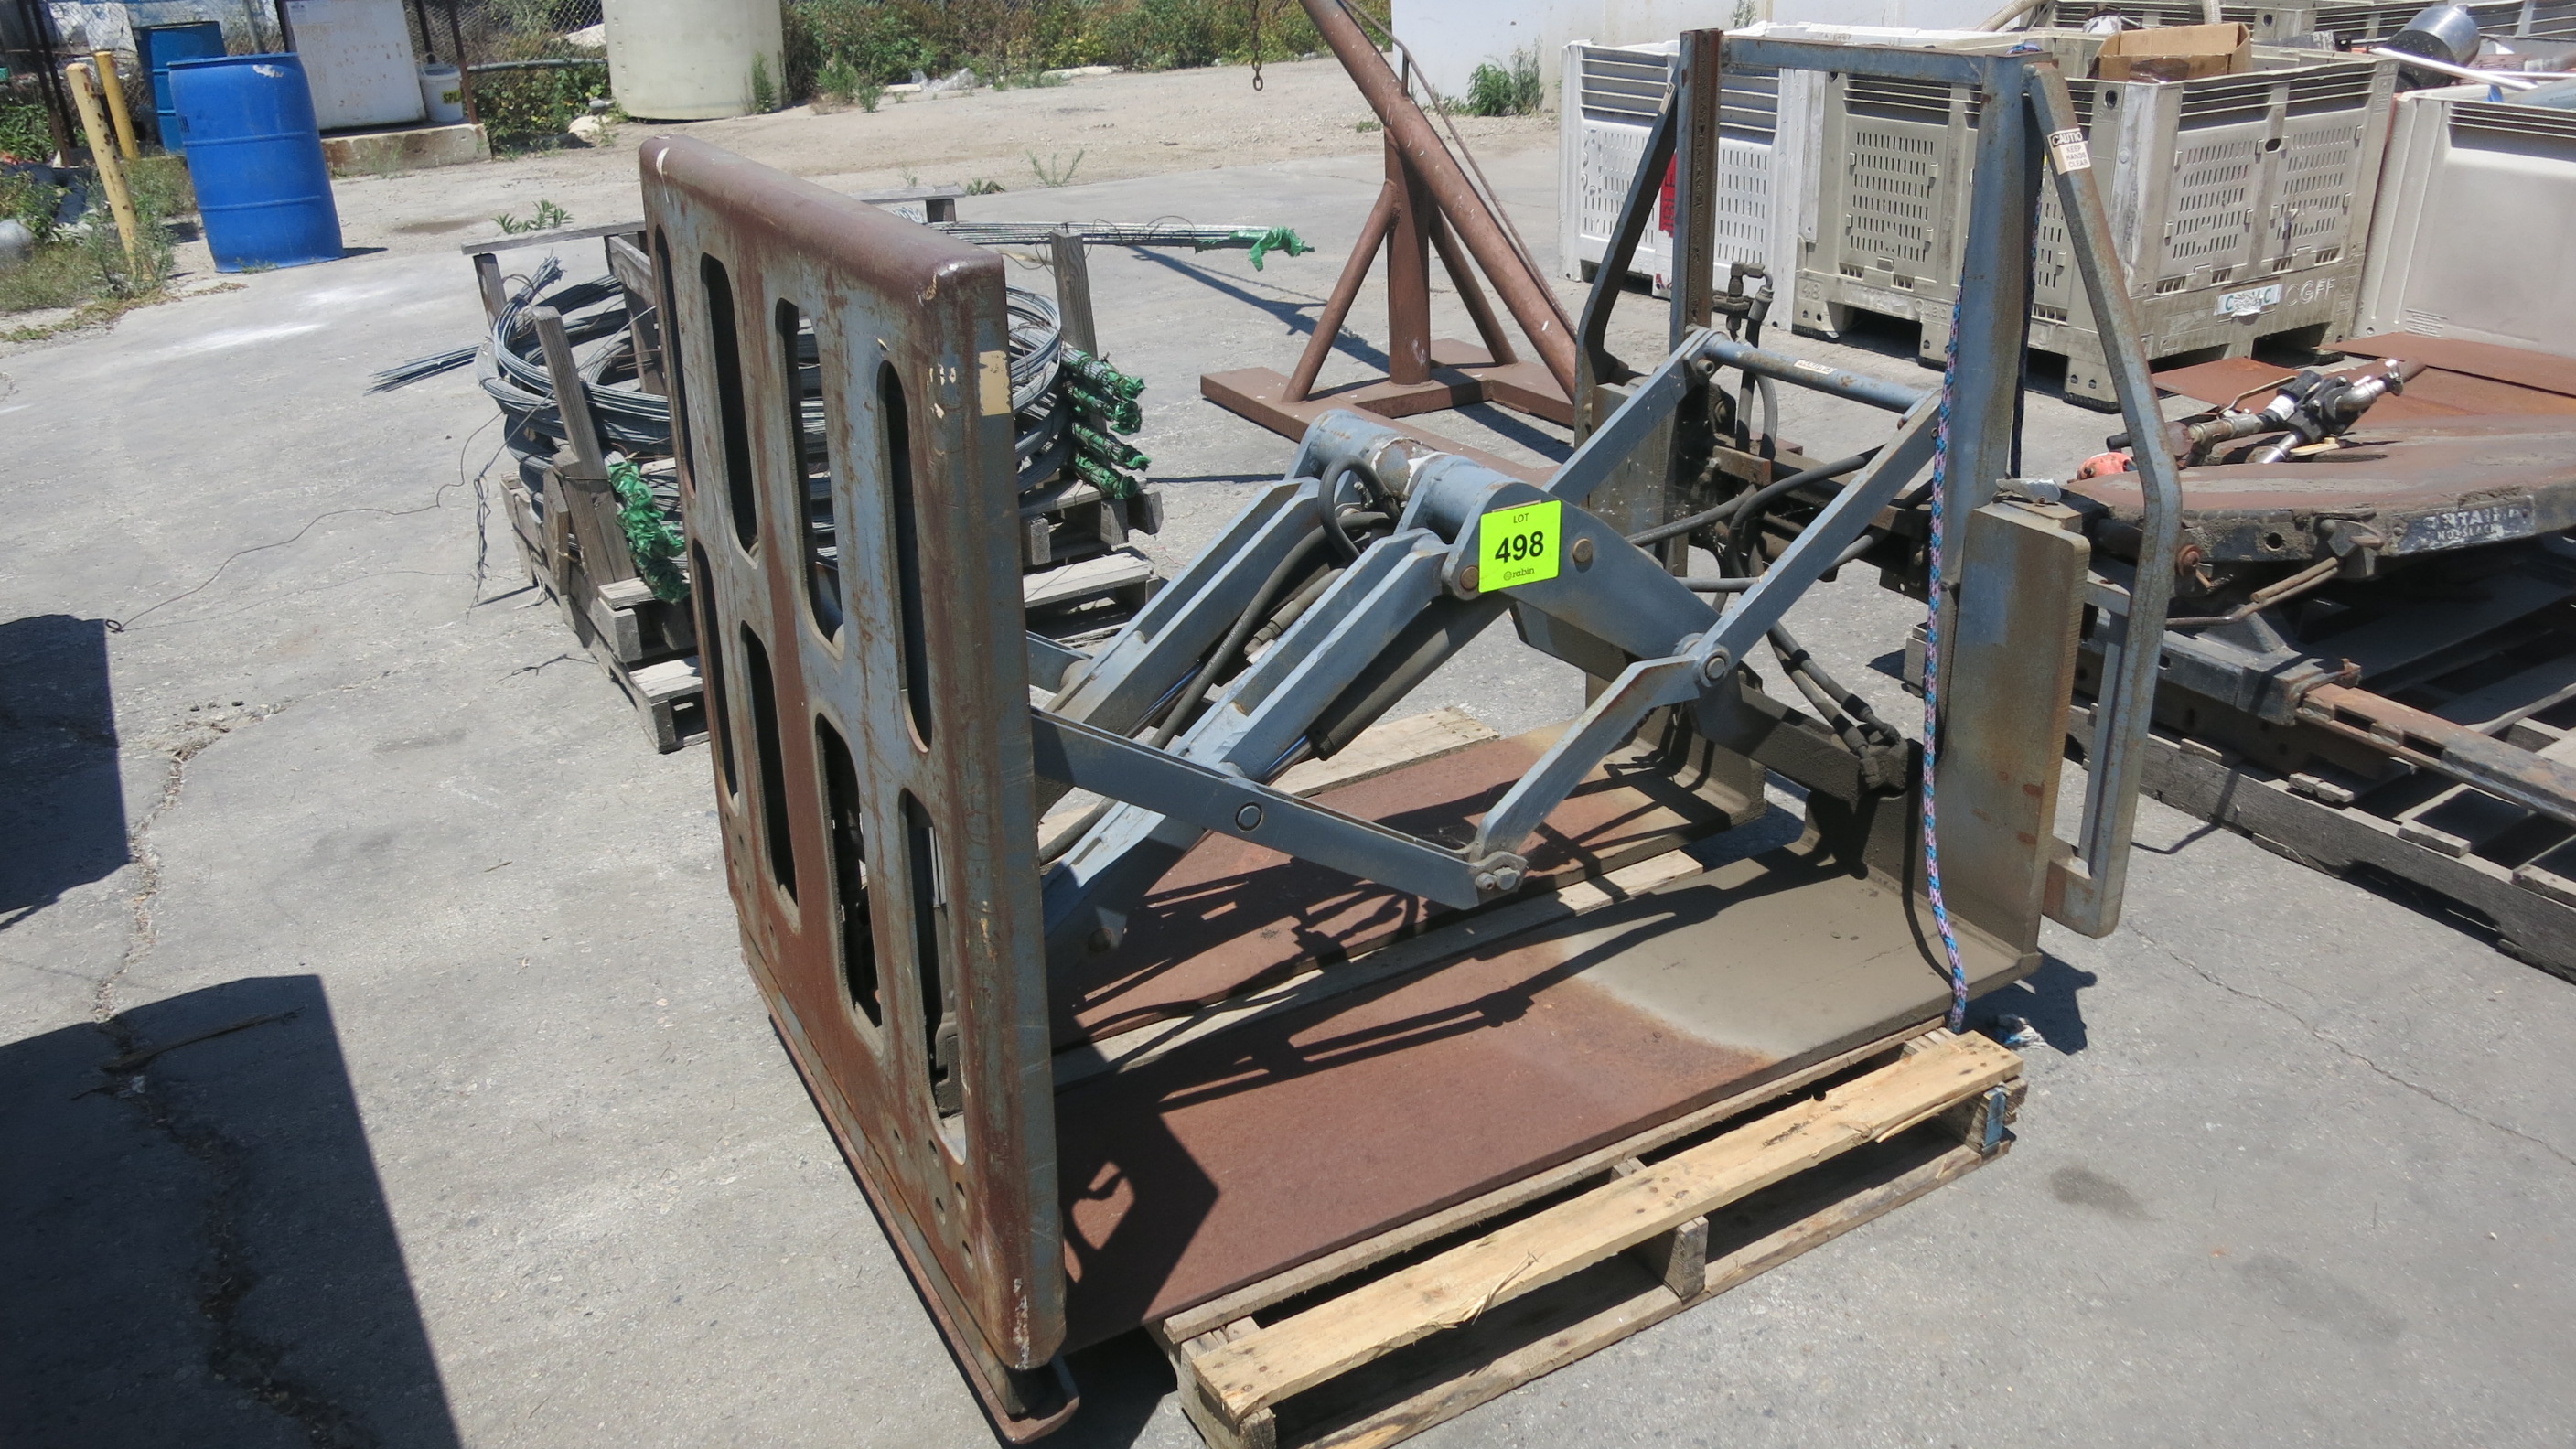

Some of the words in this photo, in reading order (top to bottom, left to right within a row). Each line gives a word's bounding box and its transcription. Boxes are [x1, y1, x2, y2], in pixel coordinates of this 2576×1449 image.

[2052, 131, 2083, 146] CAUTIO
[2066, 145, 2082, 153] KEEP
[2066, 152, 2087, 161] HANDS
[2068, 159, 2088, 168] CLEAR
[1512, 512, 1530, 524] LOT
[1495, 531, 1545, 564] 498
[1511, 566, 1535, 579] rabin
